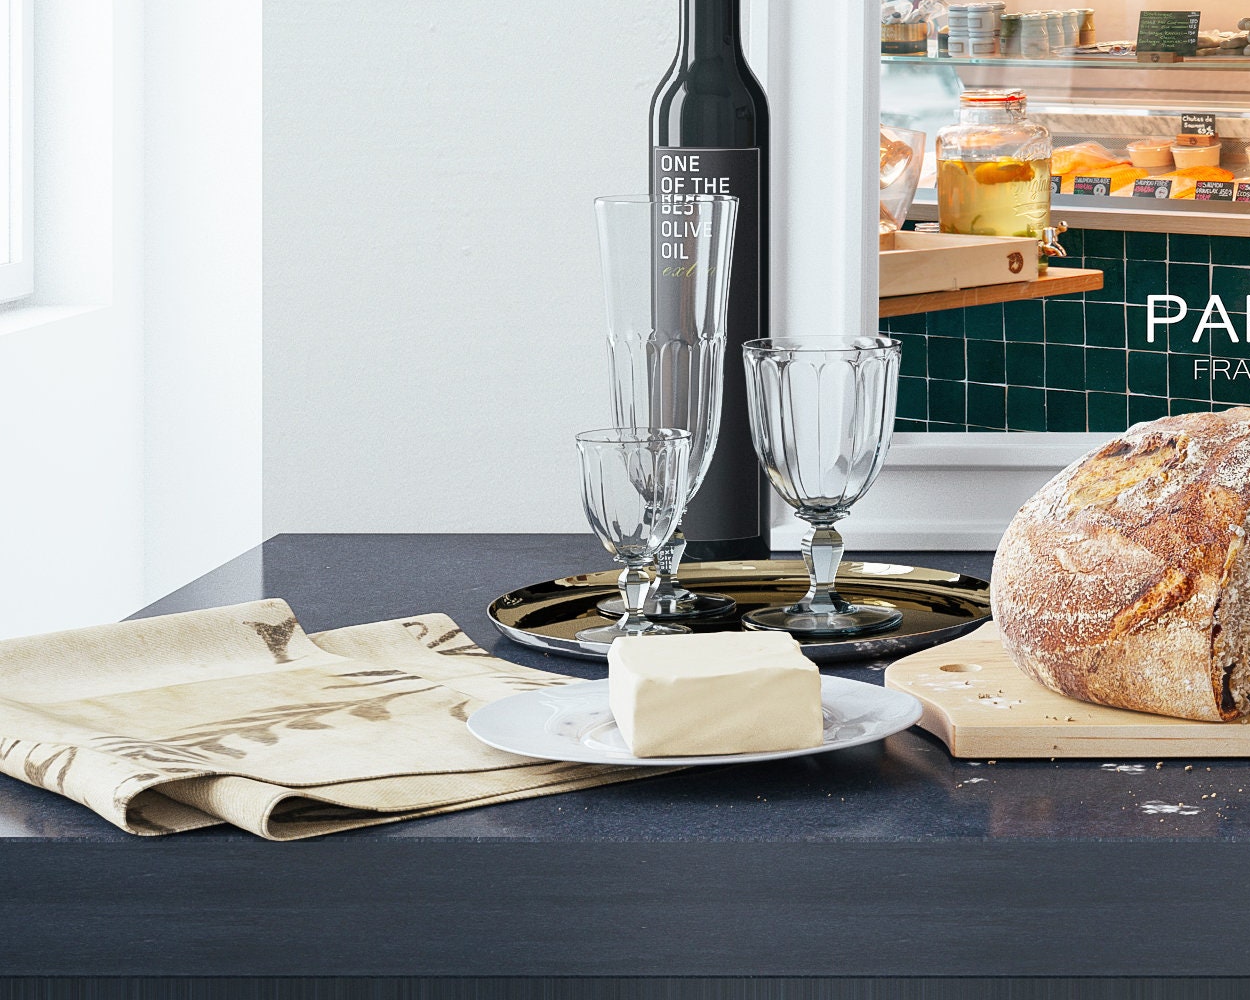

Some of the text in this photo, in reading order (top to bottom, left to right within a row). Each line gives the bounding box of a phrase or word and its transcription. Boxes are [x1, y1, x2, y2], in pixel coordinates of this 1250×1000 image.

[661, 155, 700, 172] ONE
[661, 176, 730, 194] OF THE
[661, 194, 702, 216] BEST
[661, 220, 713, 238] OLIVE
[661, 242, 689, 260] OIL
[662, 262, 718, 278] exta
